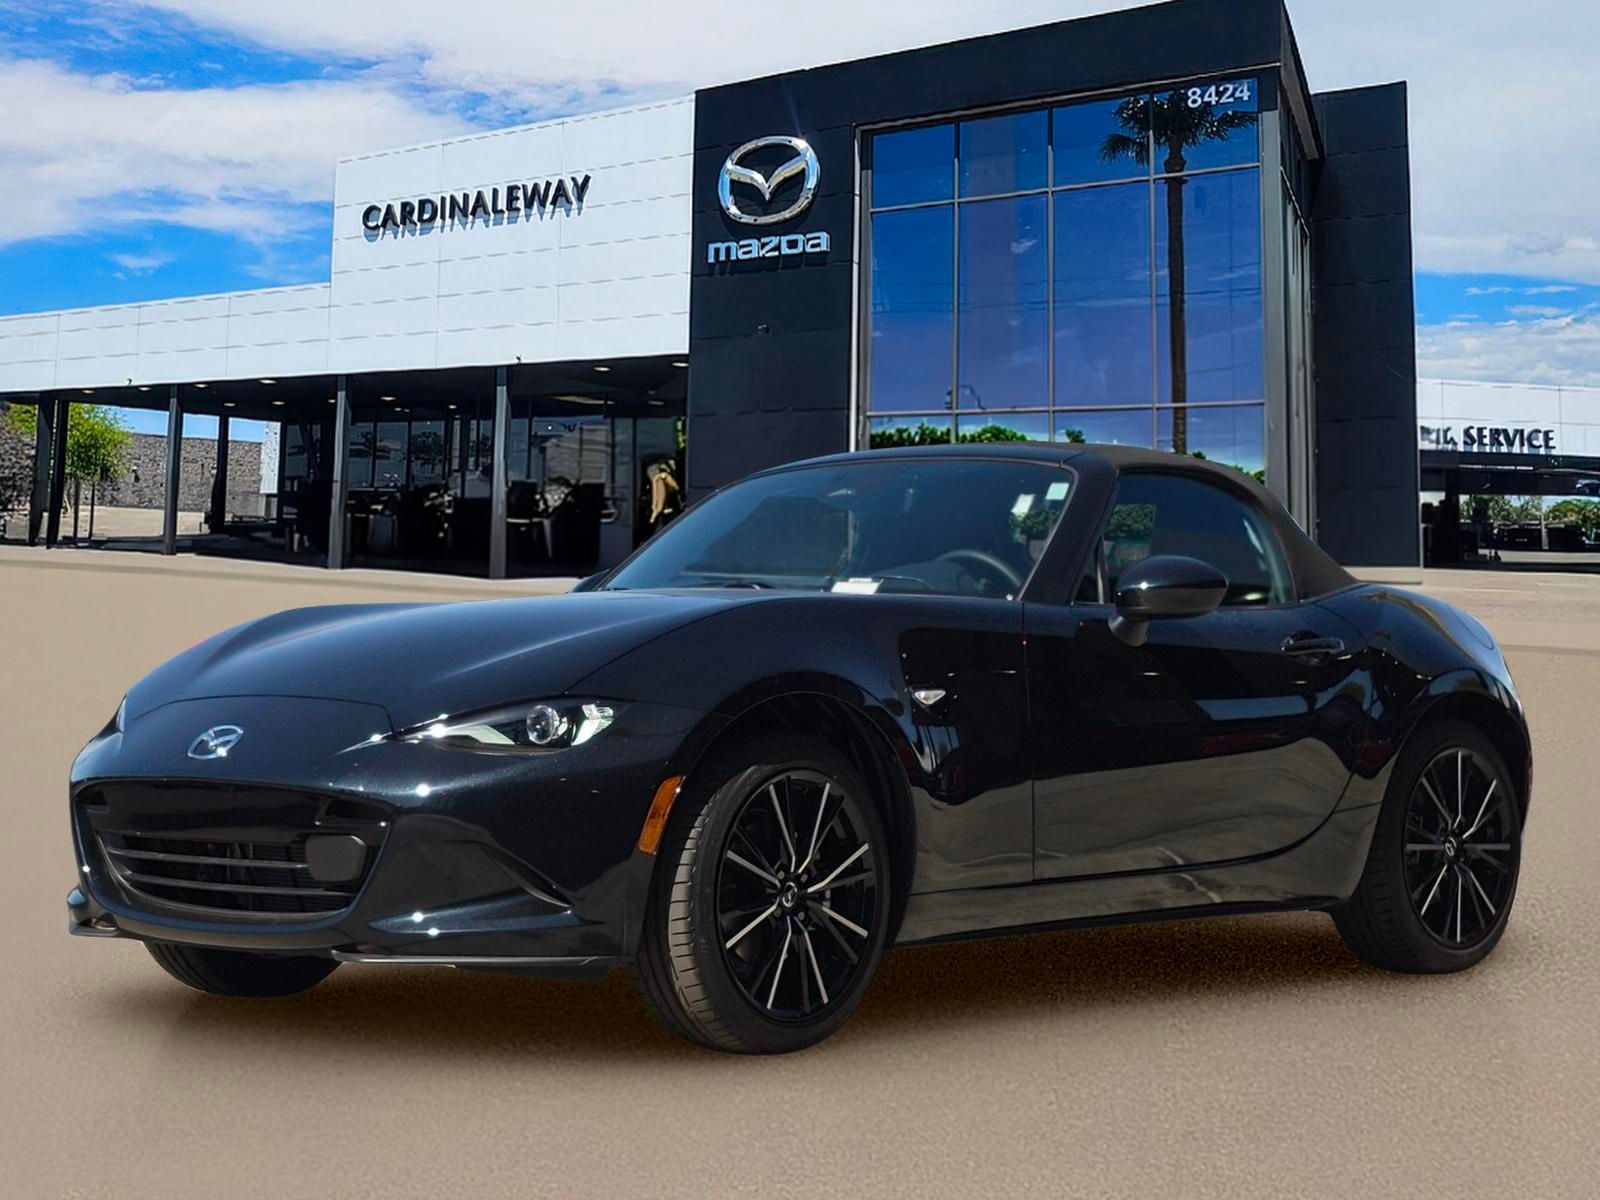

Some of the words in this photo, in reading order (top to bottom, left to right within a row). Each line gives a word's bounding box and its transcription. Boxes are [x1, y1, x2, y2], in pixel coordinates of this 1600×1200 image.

[1187, 82, 1251, 108] 8424
[362, 174, 591, 231] CARDINALEWAY
[707, 231, 830, 263] mazda
[1463, 425, 1556, 449] SERVICE
